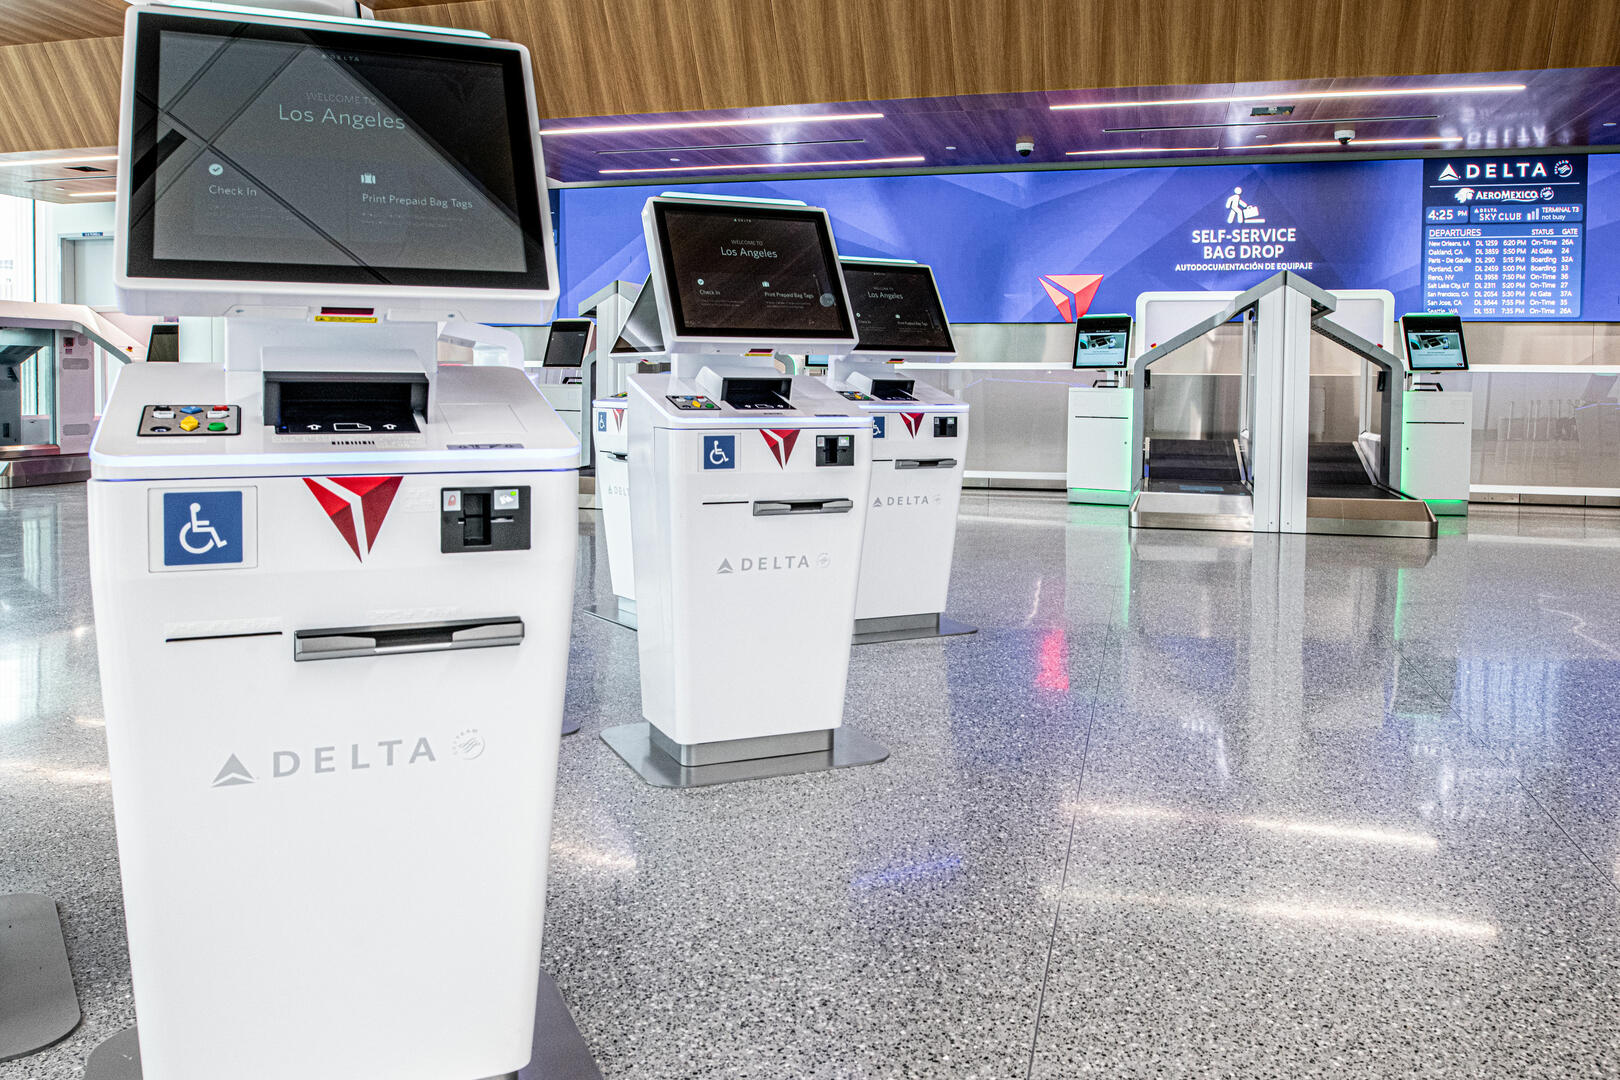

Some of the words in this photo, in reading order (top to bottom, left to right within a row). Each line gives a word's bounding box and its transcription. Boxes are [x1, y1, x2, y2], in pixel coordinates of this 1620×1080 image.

[279, 104, 314, 122] Los
[322, 108, 405, 130] Angeles
[1466, 162, 1547, 179] DELTA
[208, 184, 243, 196] Check
[246, 187, 257, 196] In
[362, 193, 386, 203] Print
[389, 195, 427, 206] Prepaid
[430, 197, 448, 209] Bag
[451, 198, 473, 209] Tags
[1428, 209, 1454, 221] 4:25
[1498, 212, 1522, 221] CLUB
[1192, 228, 1296, 243] SELF-SERVICE
[721, 246, 737, 256] Los
[740, 248, 778, 259] Angeles
[1204, 246, 1236, 259] BAG
[1240, 245, 1284, 259] DROP
[1175, 262, 1264, 271] AUTODOCUMENTACIÓN
[1276, 262, 1313, 270] EQUIPAJE
[887, 496, 929, 506] DELTA
[741, 555, 809, 571] DELTA
[273, 736, 436, 778] DELTA
